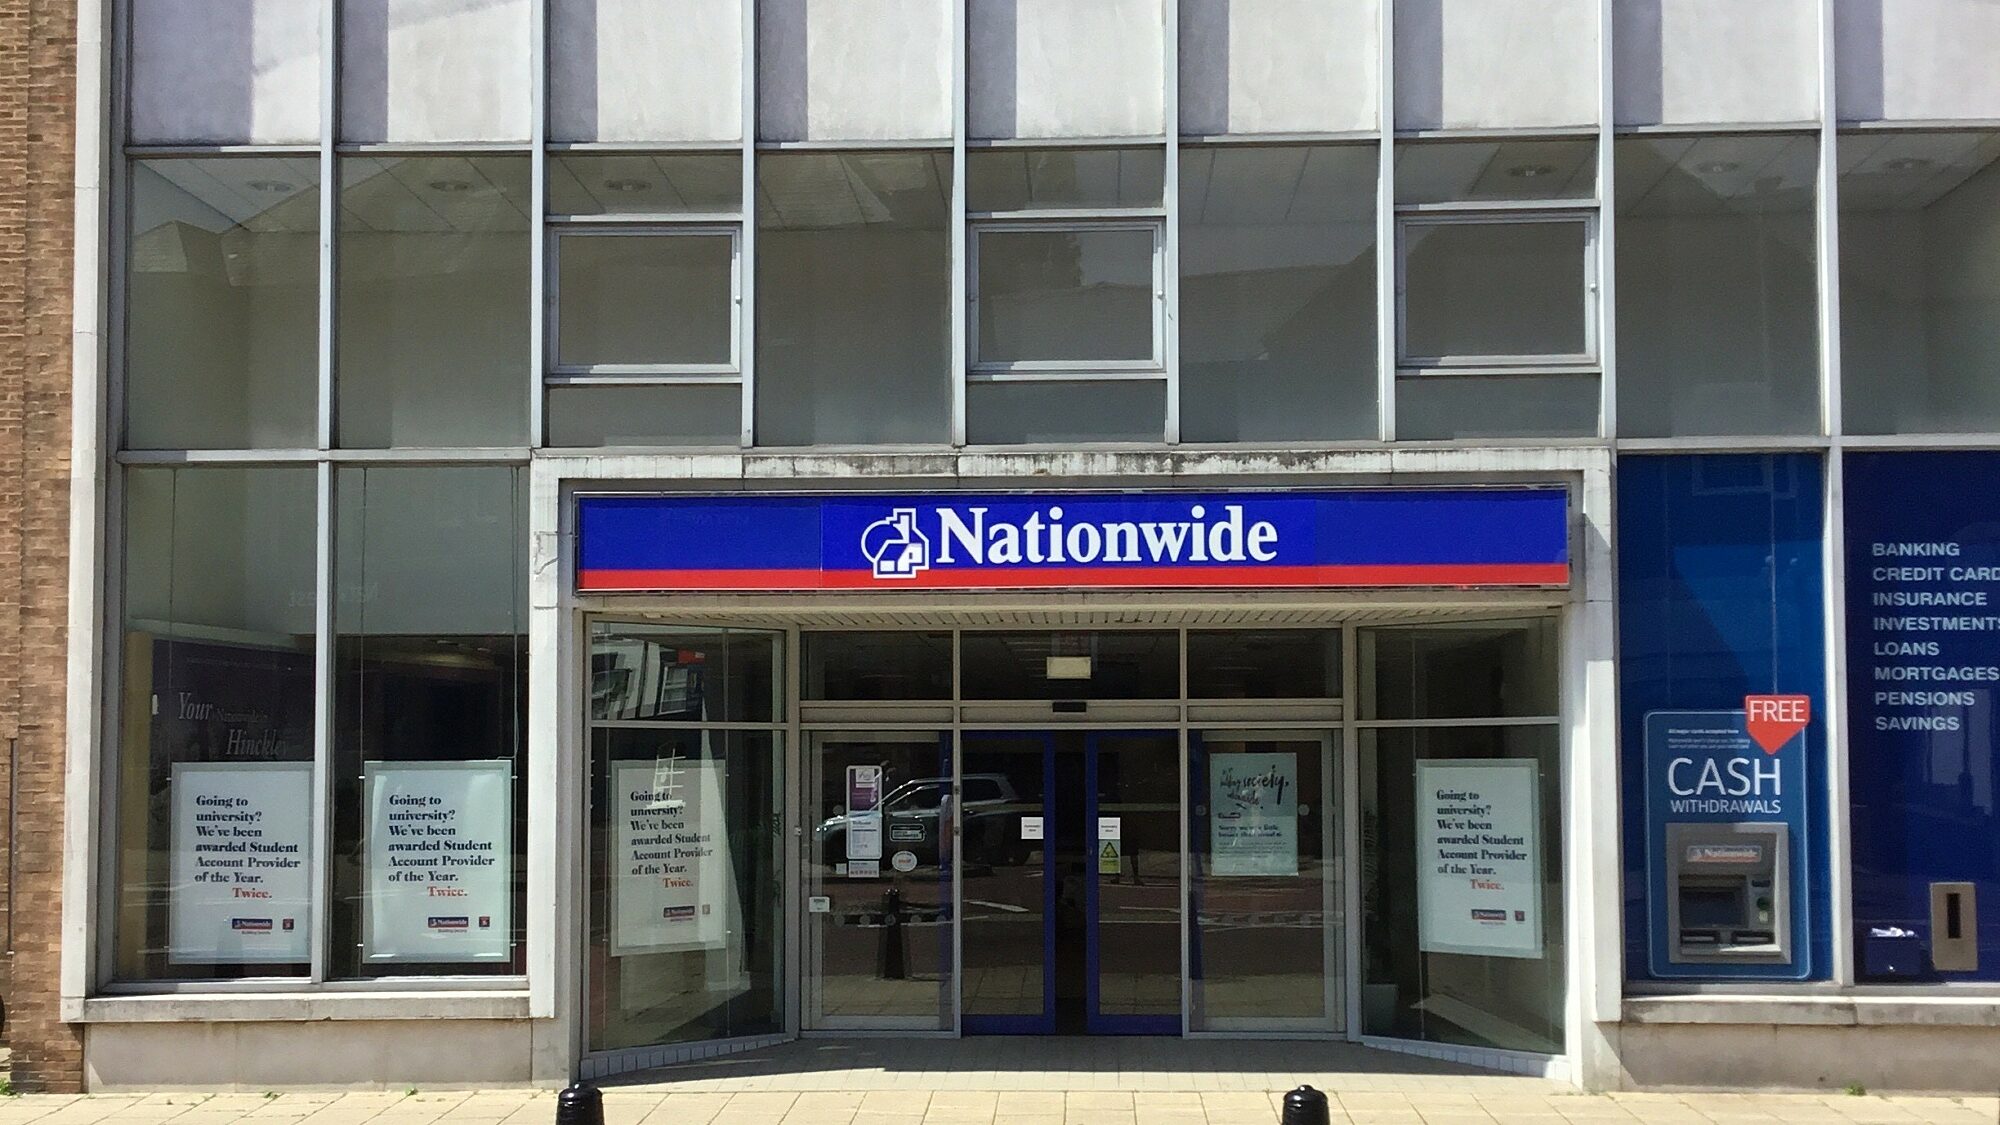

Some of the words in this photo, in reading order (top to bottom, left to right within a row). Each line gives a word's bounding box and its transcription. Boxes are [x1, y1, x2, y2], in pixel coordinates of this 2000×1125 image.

[936, 505, 1277, 563] Nationwide
[1872, 543, 1960, 556] BANKING
[1873, 567, 1944, 581] CREDIT
[1873, 592, 1987, 606] INSURANCE
[1874, 617, 2000, 631] INVESTMENT
[1874, 642, 1940, 656] LOANS
[1875, 667, 2000, 681] MORTGAGES
[1875, 692, 1975, 706] PENSIONS
[178, 692, 213, 720] Your
[1750, 700, 1806, 722] FREE
[1876, 717, 1960, 731] SAVINGS
[1668, 757, 1780, 795] CASH
[196, 795, 233, 808] Going
[236, 796, 248, 806] to
[389, 794, 426, 807] Going
[429, 796, 441, 805] to
[630, 791, 660, 802] Going
[1436, 790, 1466, 801] Going
[1469, 792, 1479, 800] to
[1437, 805, 1492, 817] university?
[1670, 800, 1781, 814] WITHDRAWALS
[196, 811, 262, 825] university?
[389, 809, 456, 823] university?
[196, 825, 230, 836] We've
[233, 827, 262, 836] been
[389, 824, 424, 835] We've
[427, 825, 456, 835] been
[630, 821, 659, 831] We've
[661, 820, 684, 829] been
[1437, 819, 1465, 830] We've
[1468, 820, 1492, 830] been
[631, 834, 672, 845] awarded
[675, 833, 711, 844] Student
[1437, 835, 1479, 845] awarded
[1482, 835, 1524, 845] Student
[195, 842, 246, 852] awarded
[249, 842, 298, 852] Student
[388, 840, 440, 851] awarded
[443, 840, 492, 850] Student
[632, 850, 671, 860] Account
[674, 848, 713, 859] Provider
[1438, 850, 1478, 860] Account
[1481, 850, 1527, 861] Provider
[195, 856, 243, 867] Account
[247, 857, 301, 868] Provider
[388, 855, 438, 866] Account
[442, 855, 495, 866] Provider
[632, 864, 644, 875] of
[645, 864, 660, 874] the
[663, 863, 687, 873] Year.
[1437, 865, 1449, 874] of
[1451, 864, 1467, 874] the
[1470, 864, 1496, 875] Year.
[194, 872, 209, 882] of
[211, 872, 229, 882] the
[233, 872, 263, 882] Year.
[388, 871, 402, 881] of
[404, 871, 424, 881] the
[428, 871, 458, 881] Year.
[663, 878, 694, 888] Twice.
[1470, 879, 1504, 890] Twice.
[232, 888, 272, 898] Twice.
[427, 886, 467, 896] Twice.
